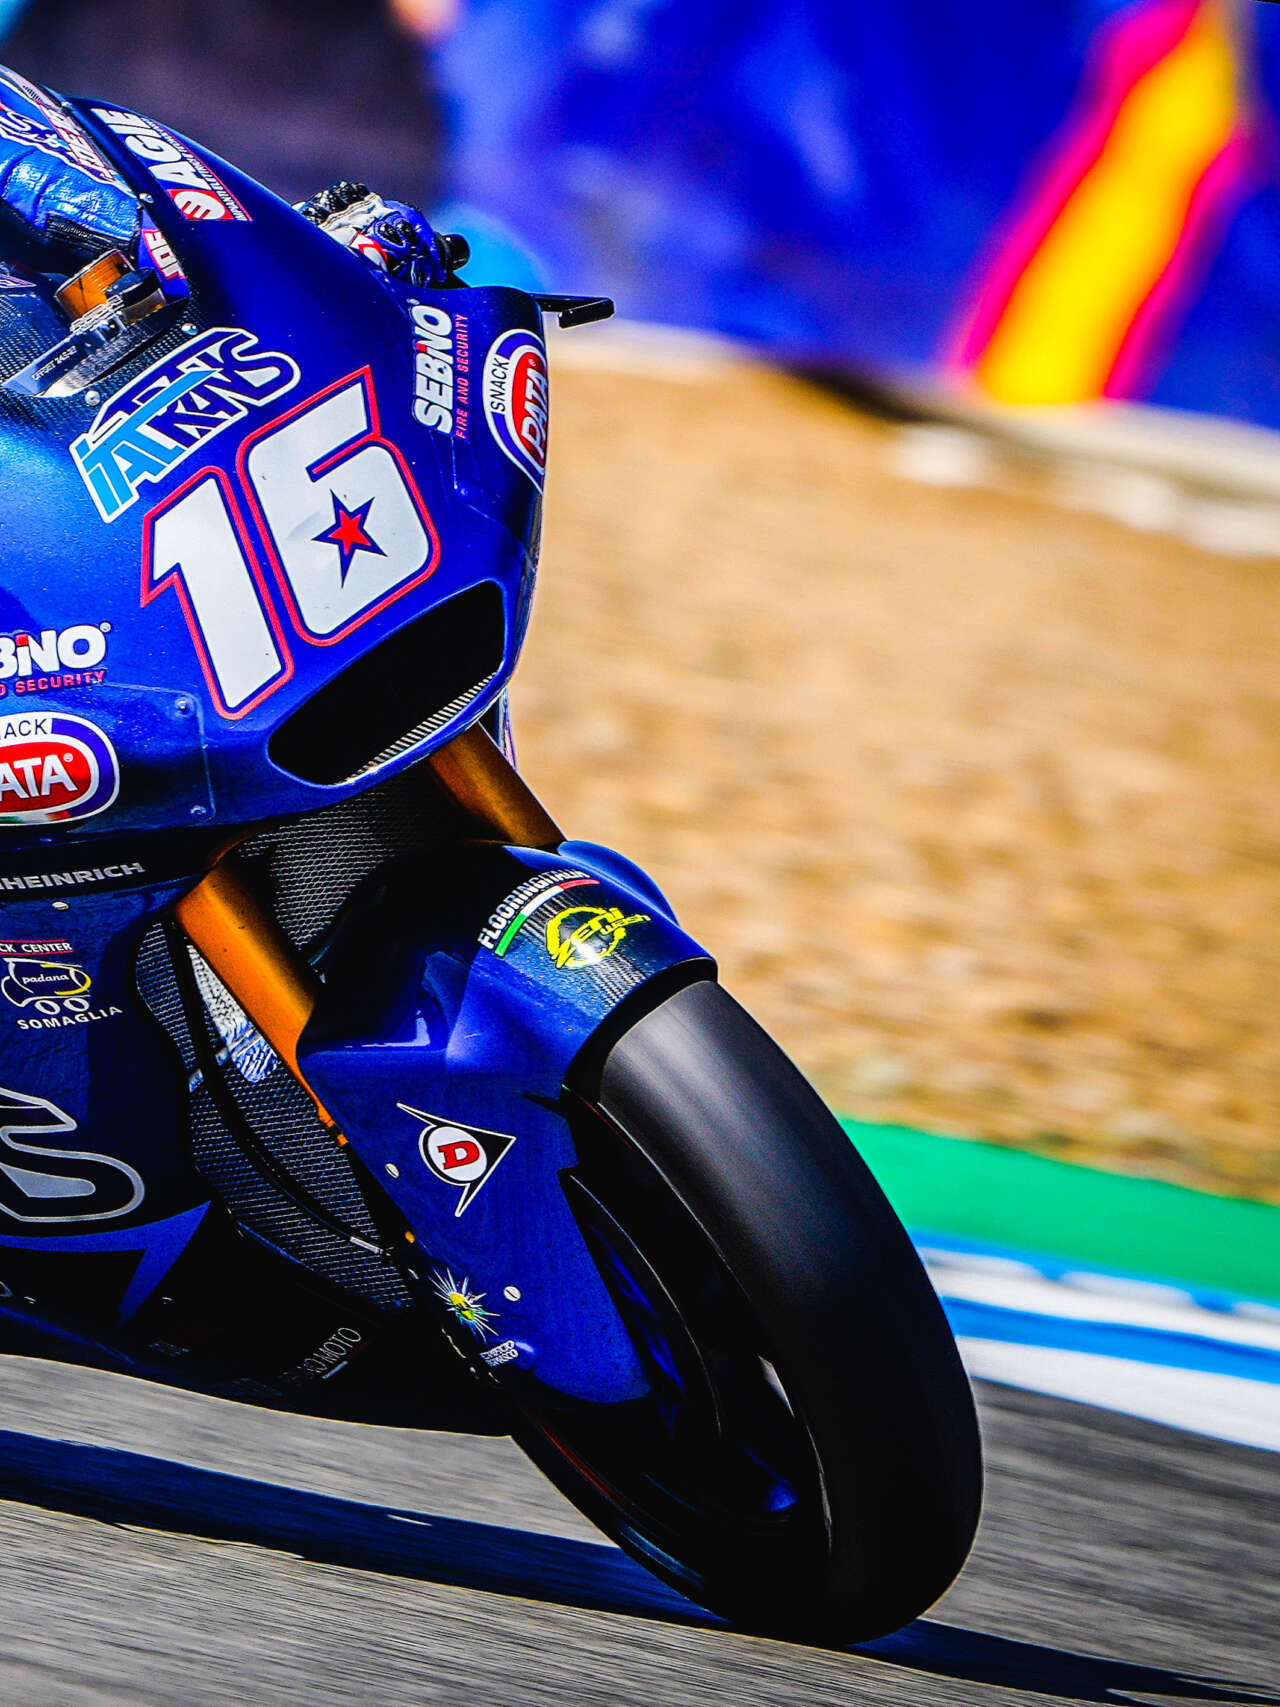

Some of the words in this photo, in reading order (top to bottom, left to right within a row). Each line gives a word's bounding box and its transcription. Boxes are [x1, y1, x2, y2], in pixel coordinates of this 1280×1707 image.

[90, 108, 213, 190] AGIE
[456, 314, 469, 372] SECURITY
[456, 377, 469, 406] AND
[491, 358, 510, 413] SNACK
[455, 409, 468, 439] FIRE
[143, 368, 438, 718] 16
[15, 670, 105, 693] SECURITY
[477, 868, 591, 951] FLOORINGITALIA
[20, 941, 72, 952] CENTER
[21, 973, 69, 984] padana
[16, 1005, 123, 1029] SOMAGLIA
[437, 1140, 480, 1171] D
